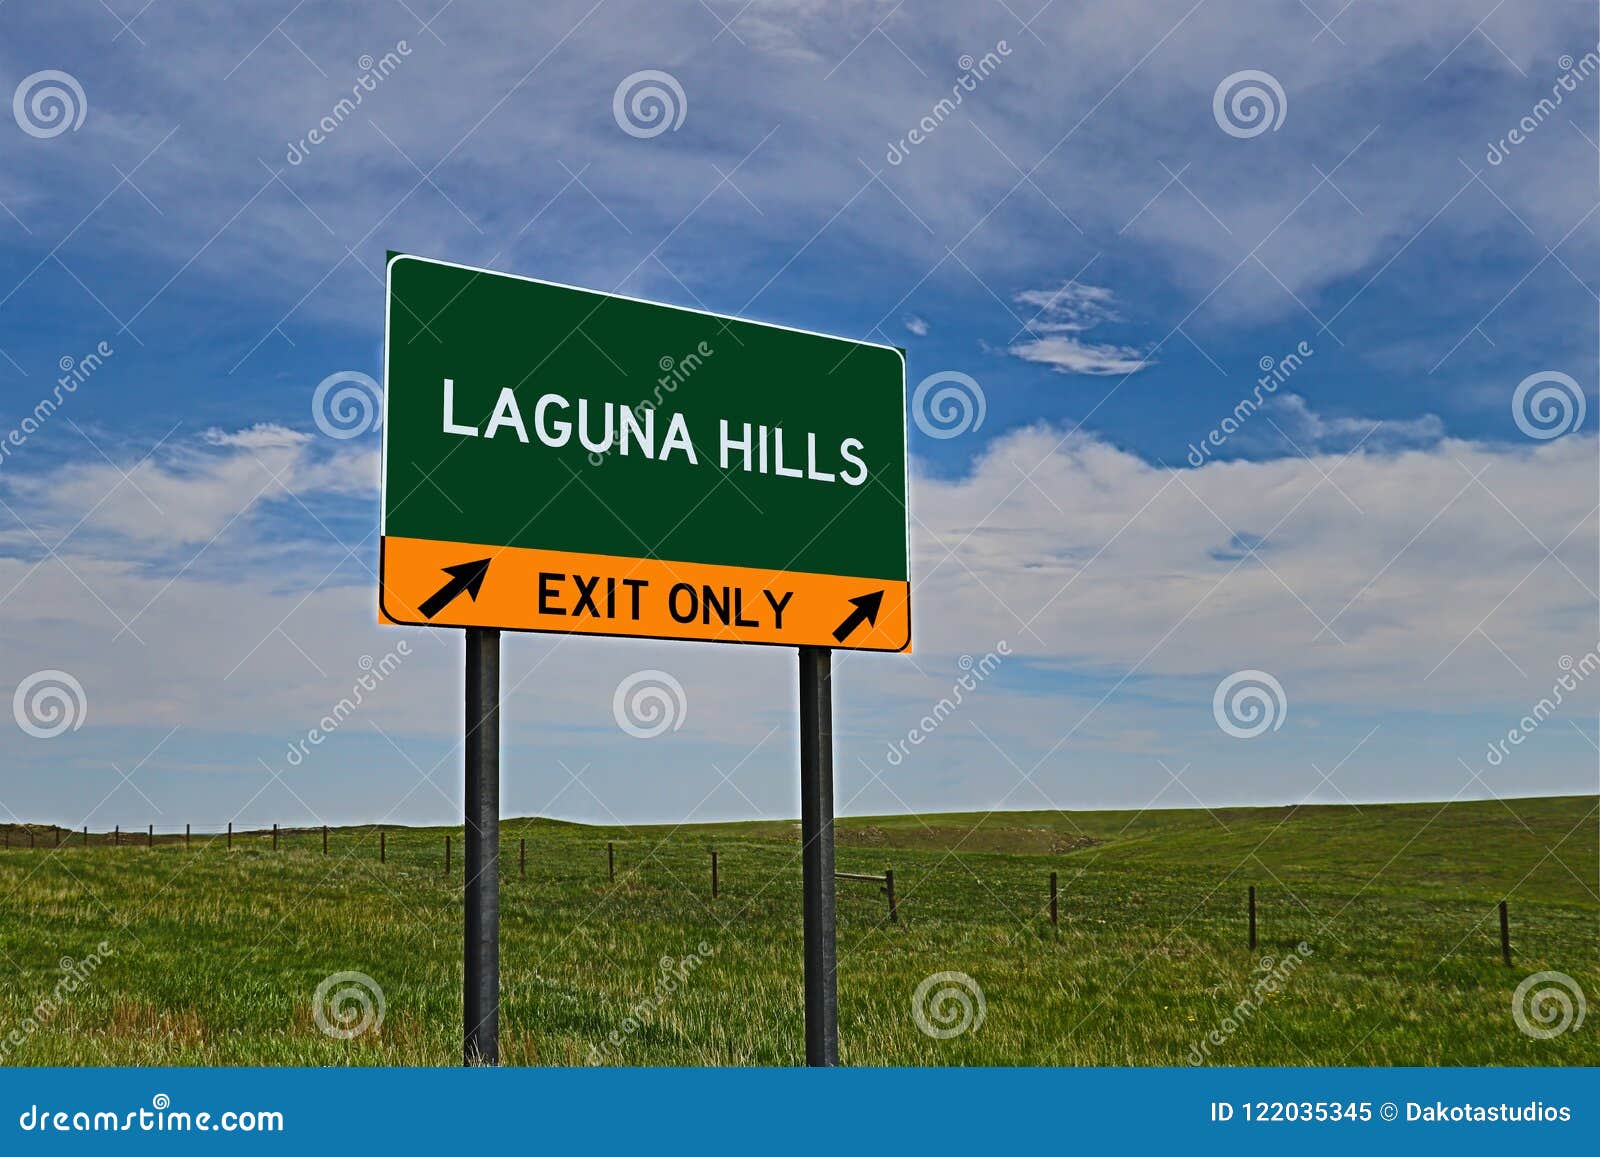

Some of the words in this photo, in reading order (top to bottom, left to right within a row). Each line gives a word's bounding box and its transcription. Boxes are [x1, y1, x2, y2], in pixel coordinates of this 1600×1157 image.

[443, 378, 698, 465] LAGUNA
[720, 419, 868, 486] HILLS
[538, 572, 649, 620] EXIT
[668, 582, 794, 629] ONLY
